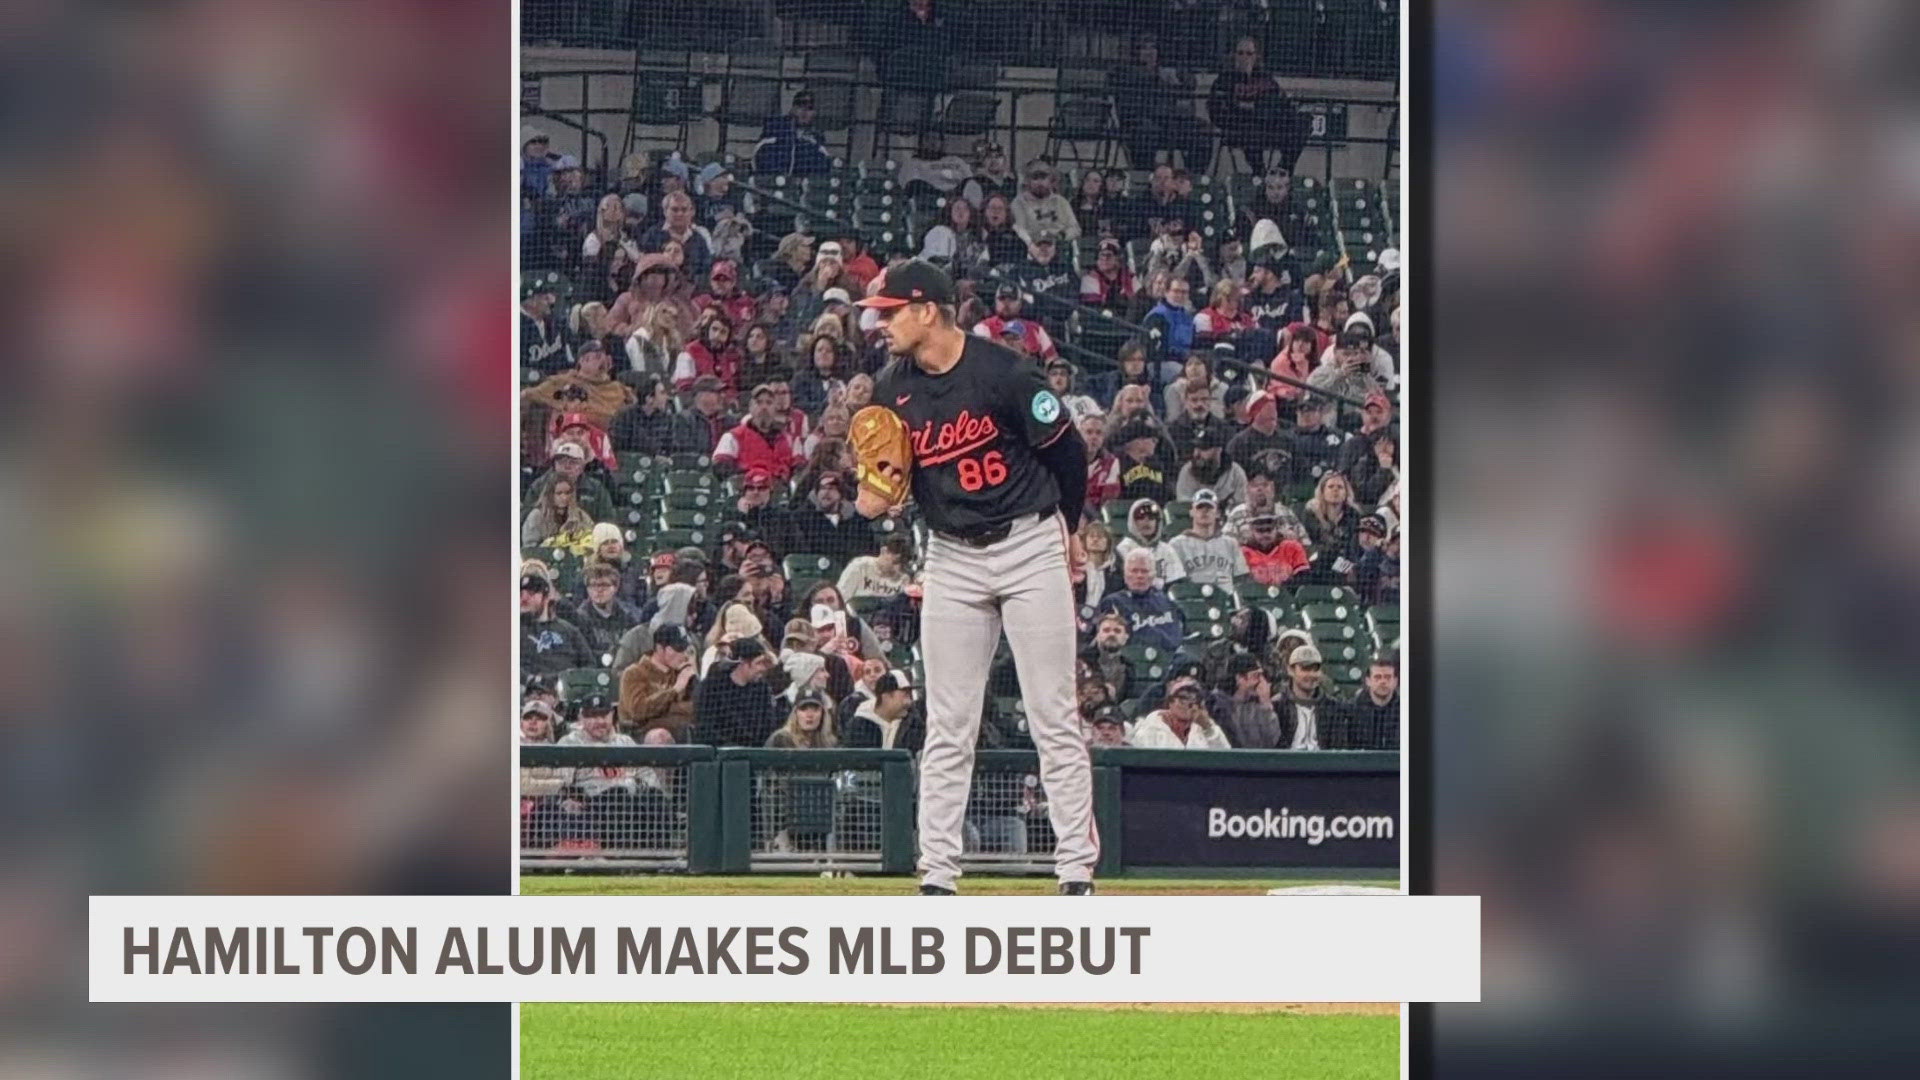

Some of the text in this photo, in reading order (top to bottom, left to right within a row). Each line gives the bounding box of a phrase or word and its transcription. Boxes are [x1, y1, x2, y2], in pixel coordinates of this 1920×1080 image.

[902, 410, 998, 467] rioles
[957, 451, 1006, 491] 86
[1208, 807, 1394, 845] Booking.com
